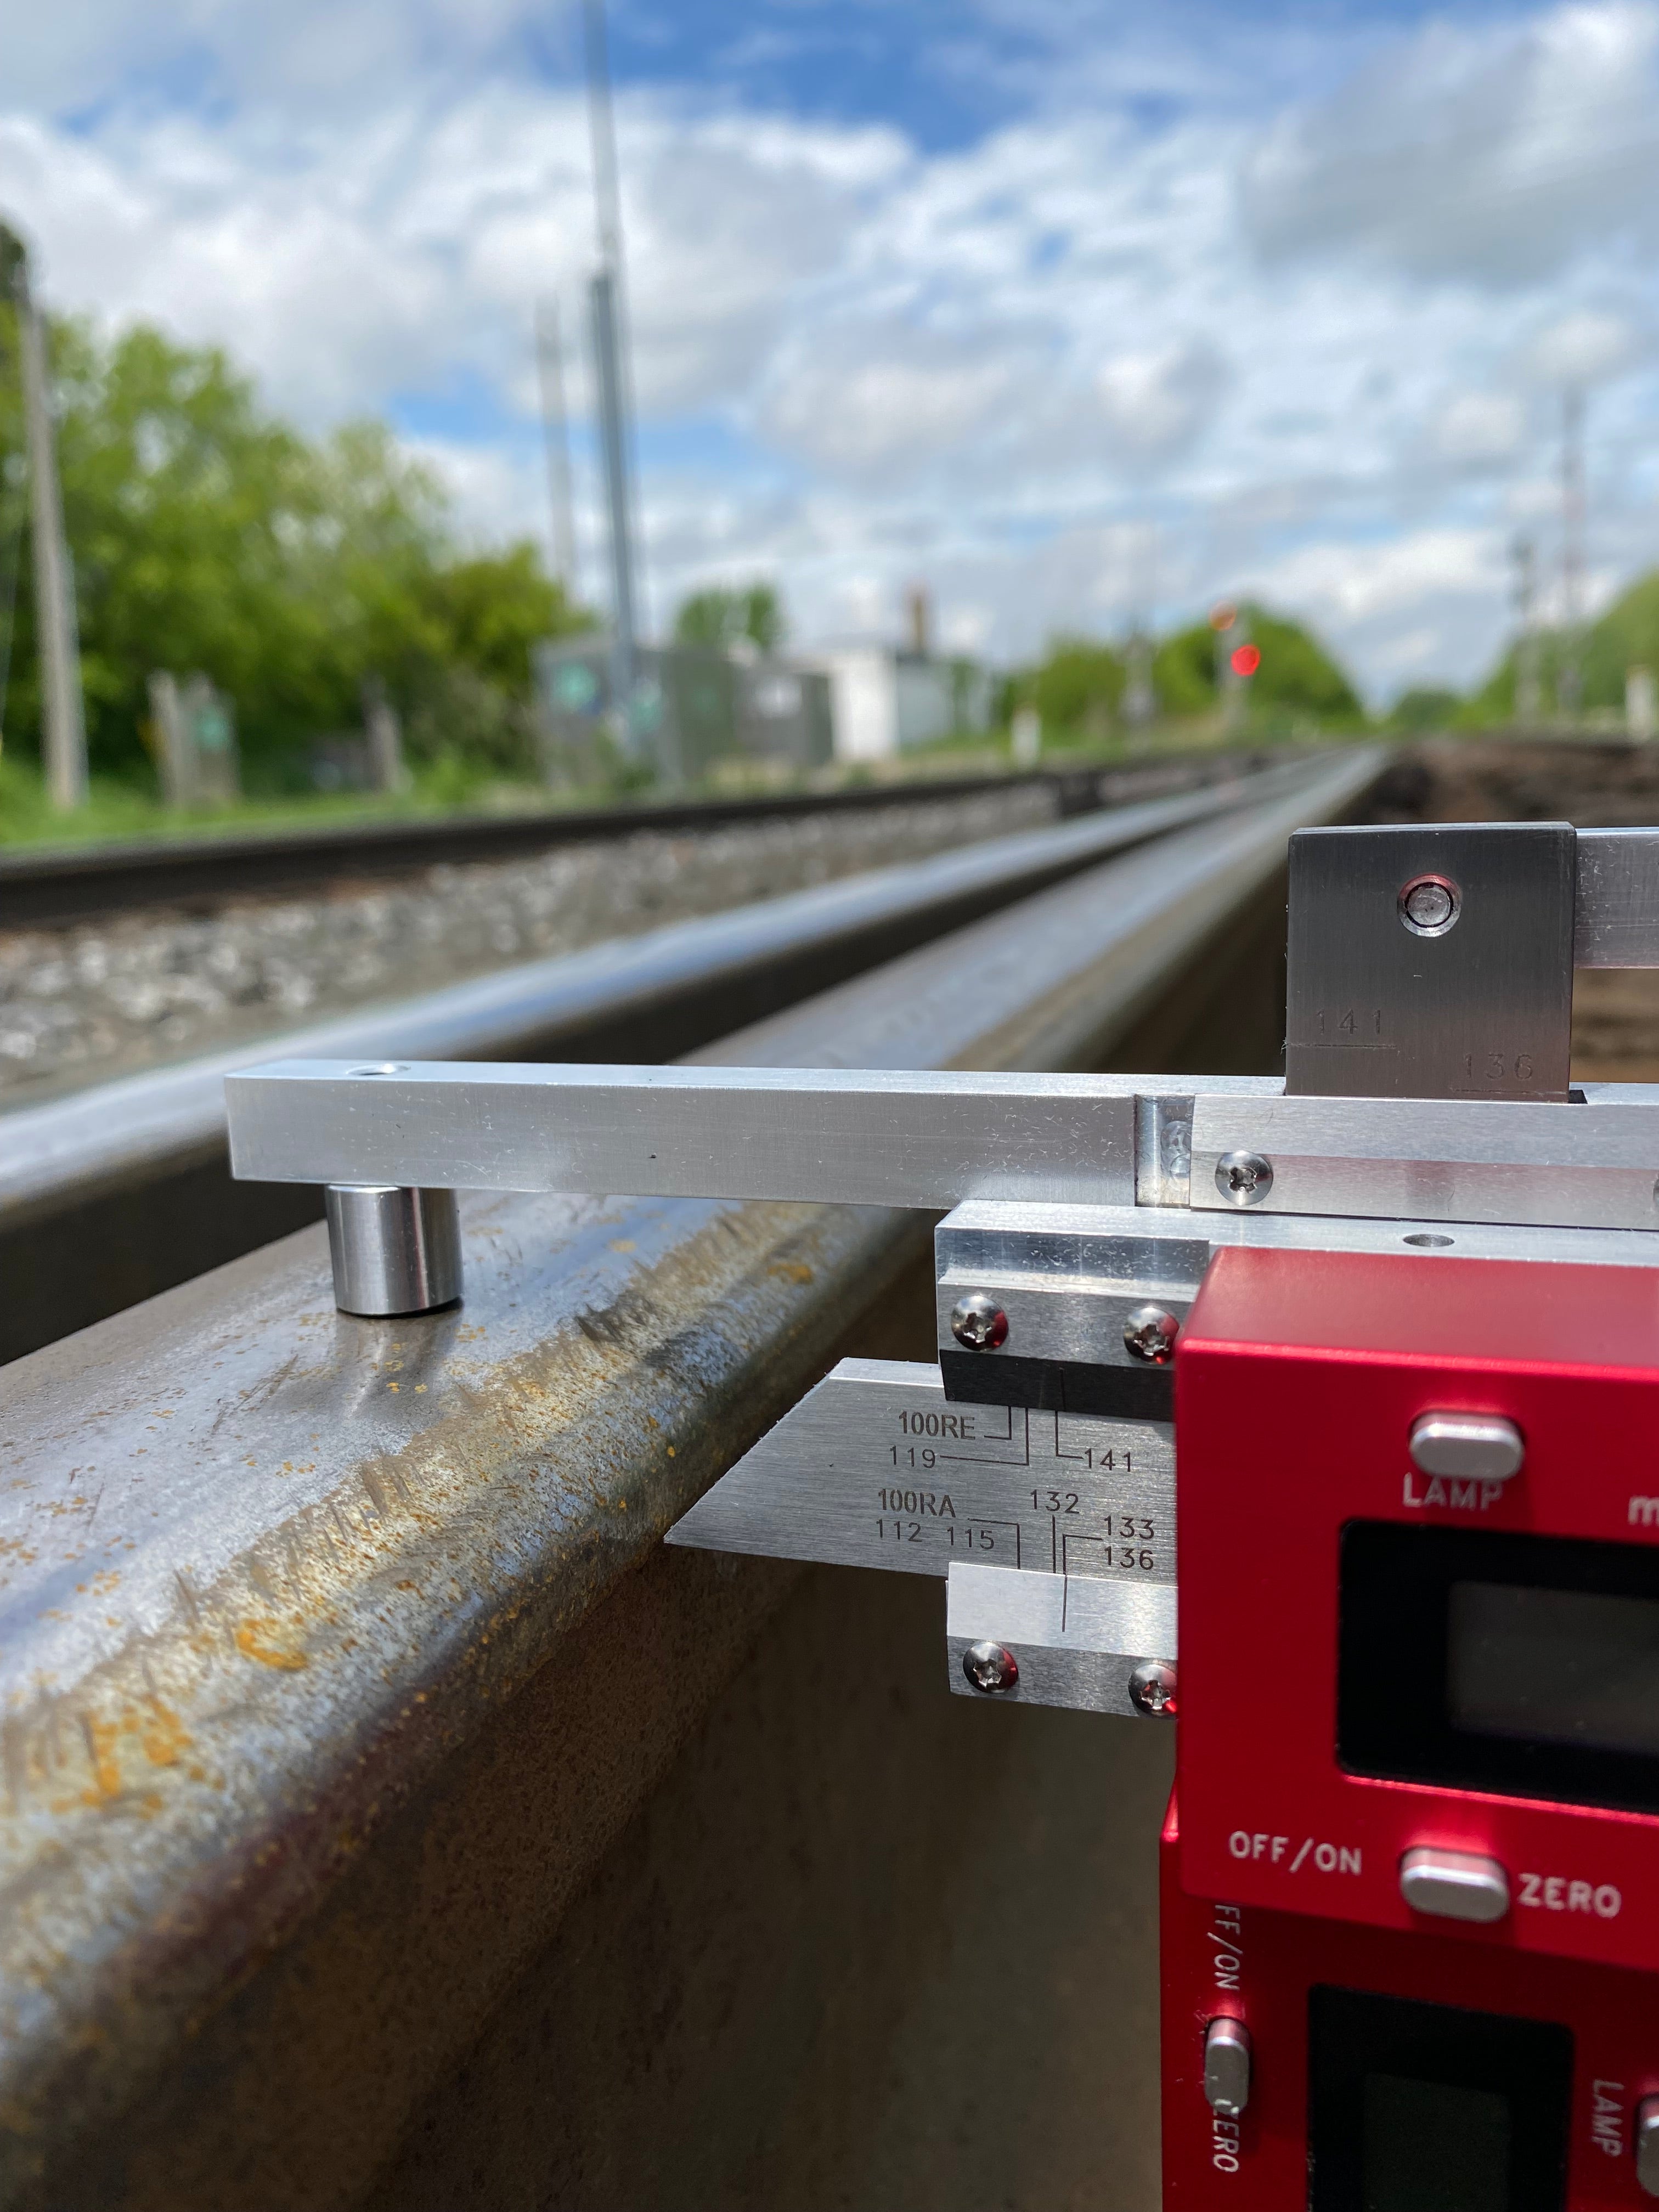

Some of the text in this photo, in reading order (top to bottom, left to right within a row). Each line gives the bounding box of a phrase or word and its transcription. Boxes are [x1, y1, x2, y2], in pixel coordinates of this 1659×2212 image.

[1317, 1009, 1382, 1035] 141
[1463, 1053, 1533, 1081] 136
[899, 1410, 975, 1440] 100RE
[889, 1445, 935, 1469] 119
[1084, 1448, 1131, 1472] 141
[878, 1488, 956, 1518] 100RA
[1030, 1489, 1080, 1514] 132
[1403, 1472, 1503, 1511] LAMP
[876, 1519, 995, 1550] 112 115
[1104, 1516, 1154, 1540] 133
[1105, 1547, 1154, 1571] 136
[1229, 1831, 1363, 1876] OFF/ON
[1519, 1872, 1622, 1919] ZERO
[1207, 1904, 1243, 1991] FF/ON
[1592, 2079, 1624, 2157] LAMP
